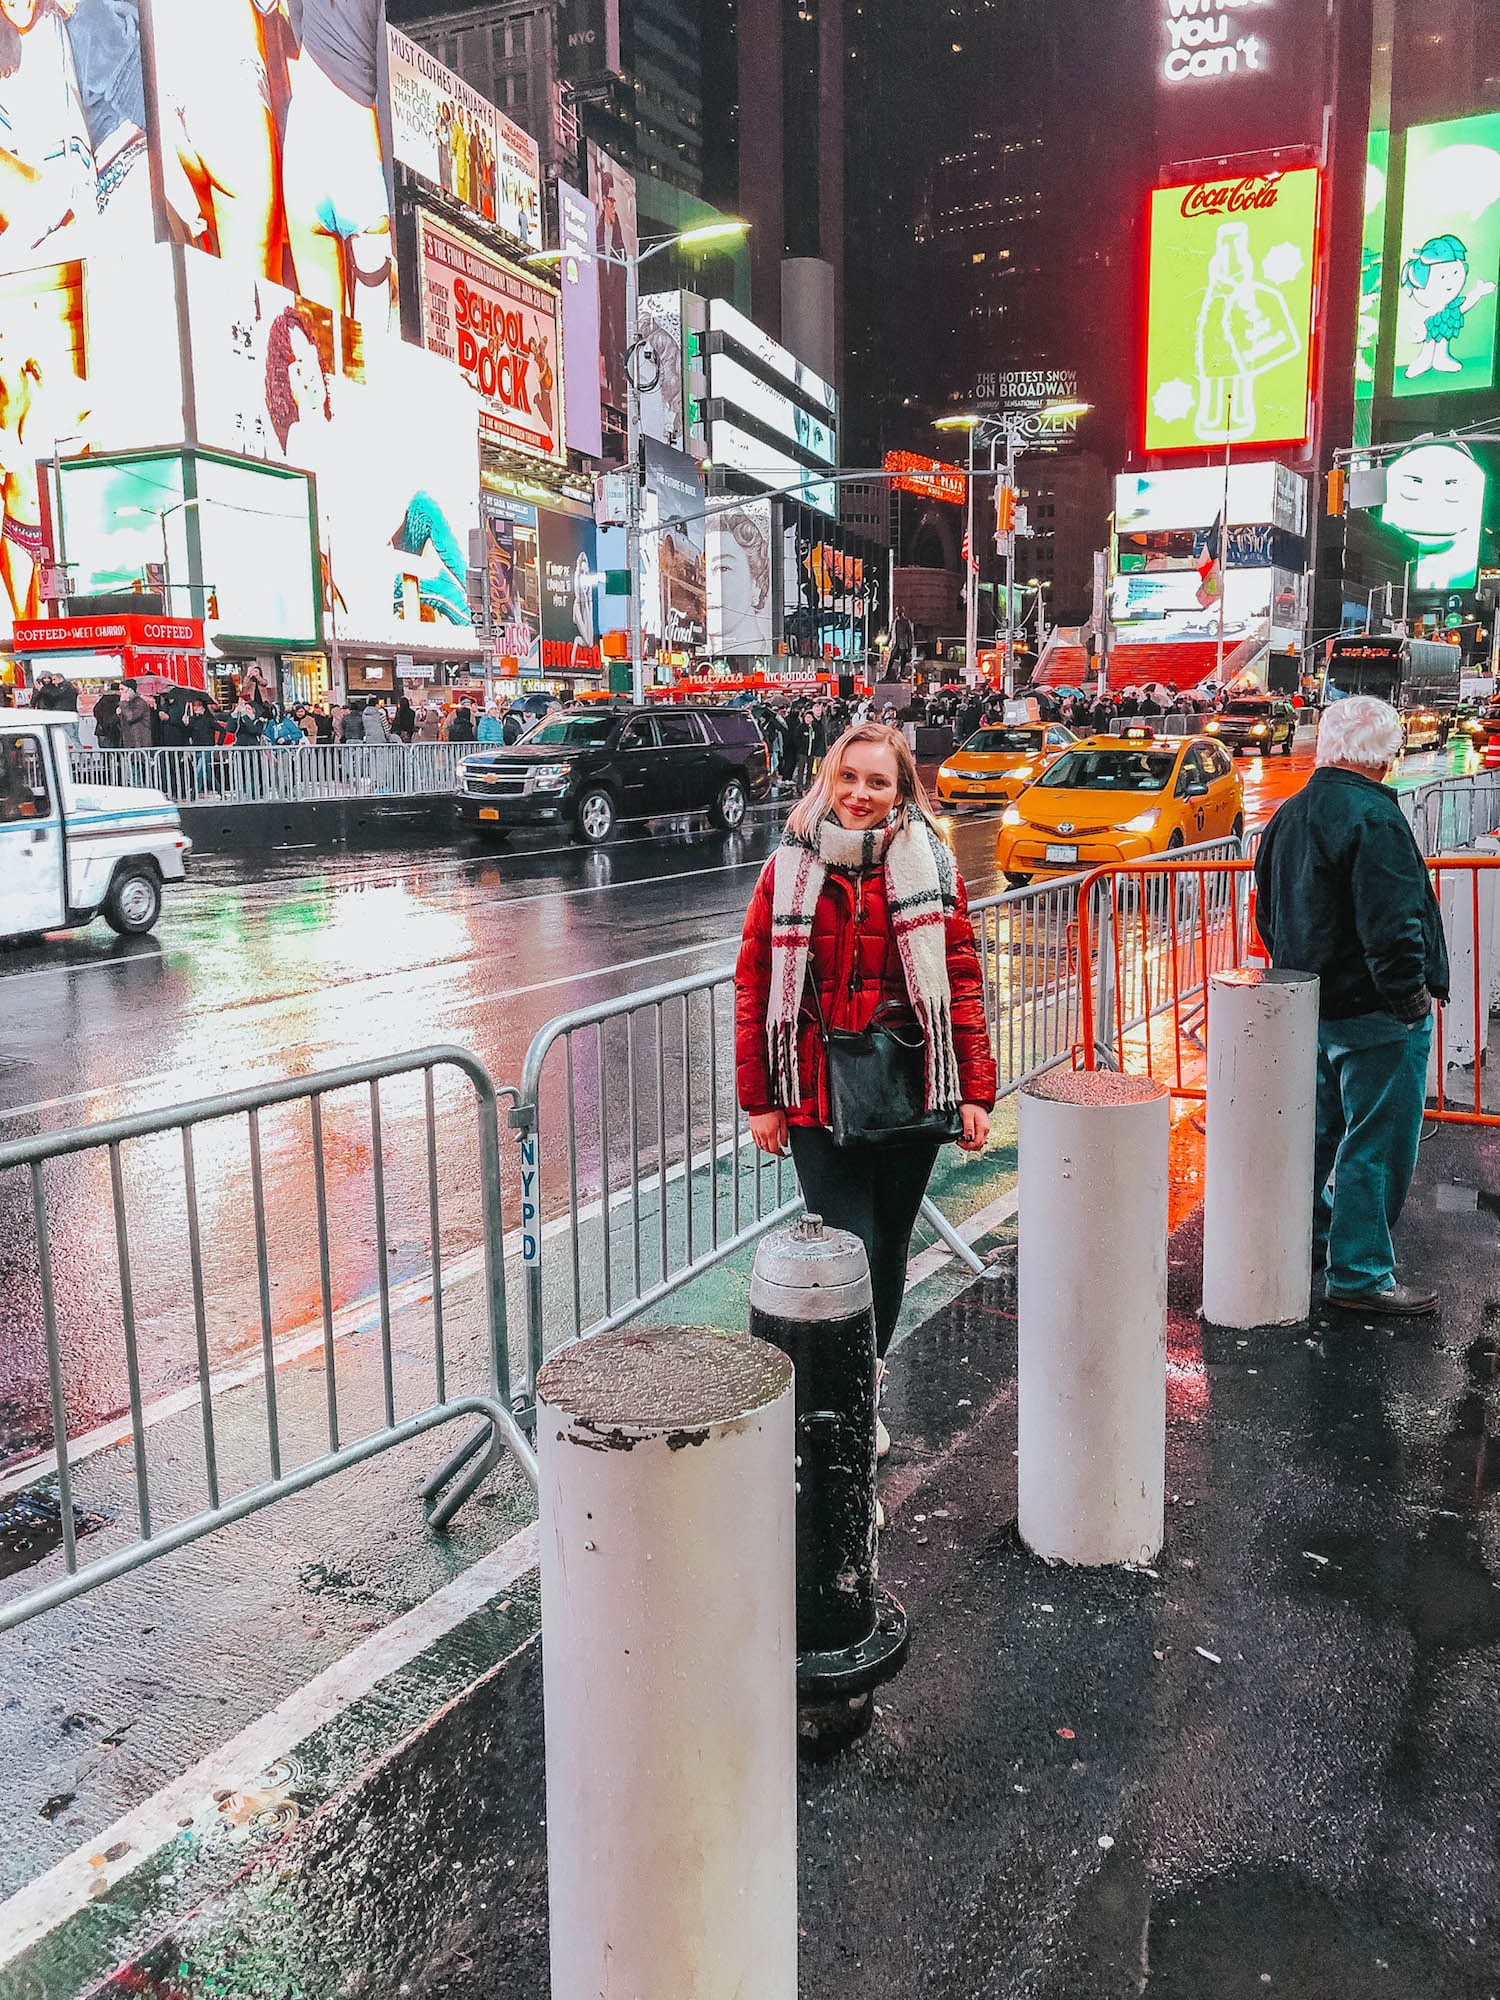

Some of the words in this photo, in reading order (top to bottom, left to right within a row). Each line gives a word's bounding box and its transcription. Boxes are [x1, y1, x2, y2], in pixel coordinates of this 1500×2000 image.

[568, 29, 596, 47] NYC
[1166, 14, 1228, 50] You
[1164, 36, 1260, 81] Can't
[391, 31, 415, 66] MUST
[418, 52, 452, 94] CLOTHES
[454, 81, 488, 124] JANUARY
[487, 109, 493, 128] 6
[396, 72, 410, 91] THE
[410, 78, 432, 106] PLAY
[393, 84, 412, 107] THAT
[411, 97, 437, 126] GOES
[393, 101, 437, 149] WRONG
[1180, 174, 1282, 218] Coca-Cola
[453, 277, 530, 355] SCHOOL
[975, 384, 995, 398] ON
[1000, 382, 1077, 398] BROADWAY!
[976, 372, 996, 385] THE
[999, 371, 1044, 384] HOTTEST
[1046, 370, 1076, 383] SNOW
[1002, 411, 1077, 438] FROZEN
[16, 627, 67, 642] COFFEED
[71, 627, 93, 639] SWEET
[95, 624, 127, 638] CHURROS
[143, 623, 193, 640] COFFEED
[541, 639, 602, 671] CHICAGO
[763, 672, 780, 683] NYC
[780, 670, 817, 682] HOTDOGS
[520, 1138, 537, 1261] NYPD
